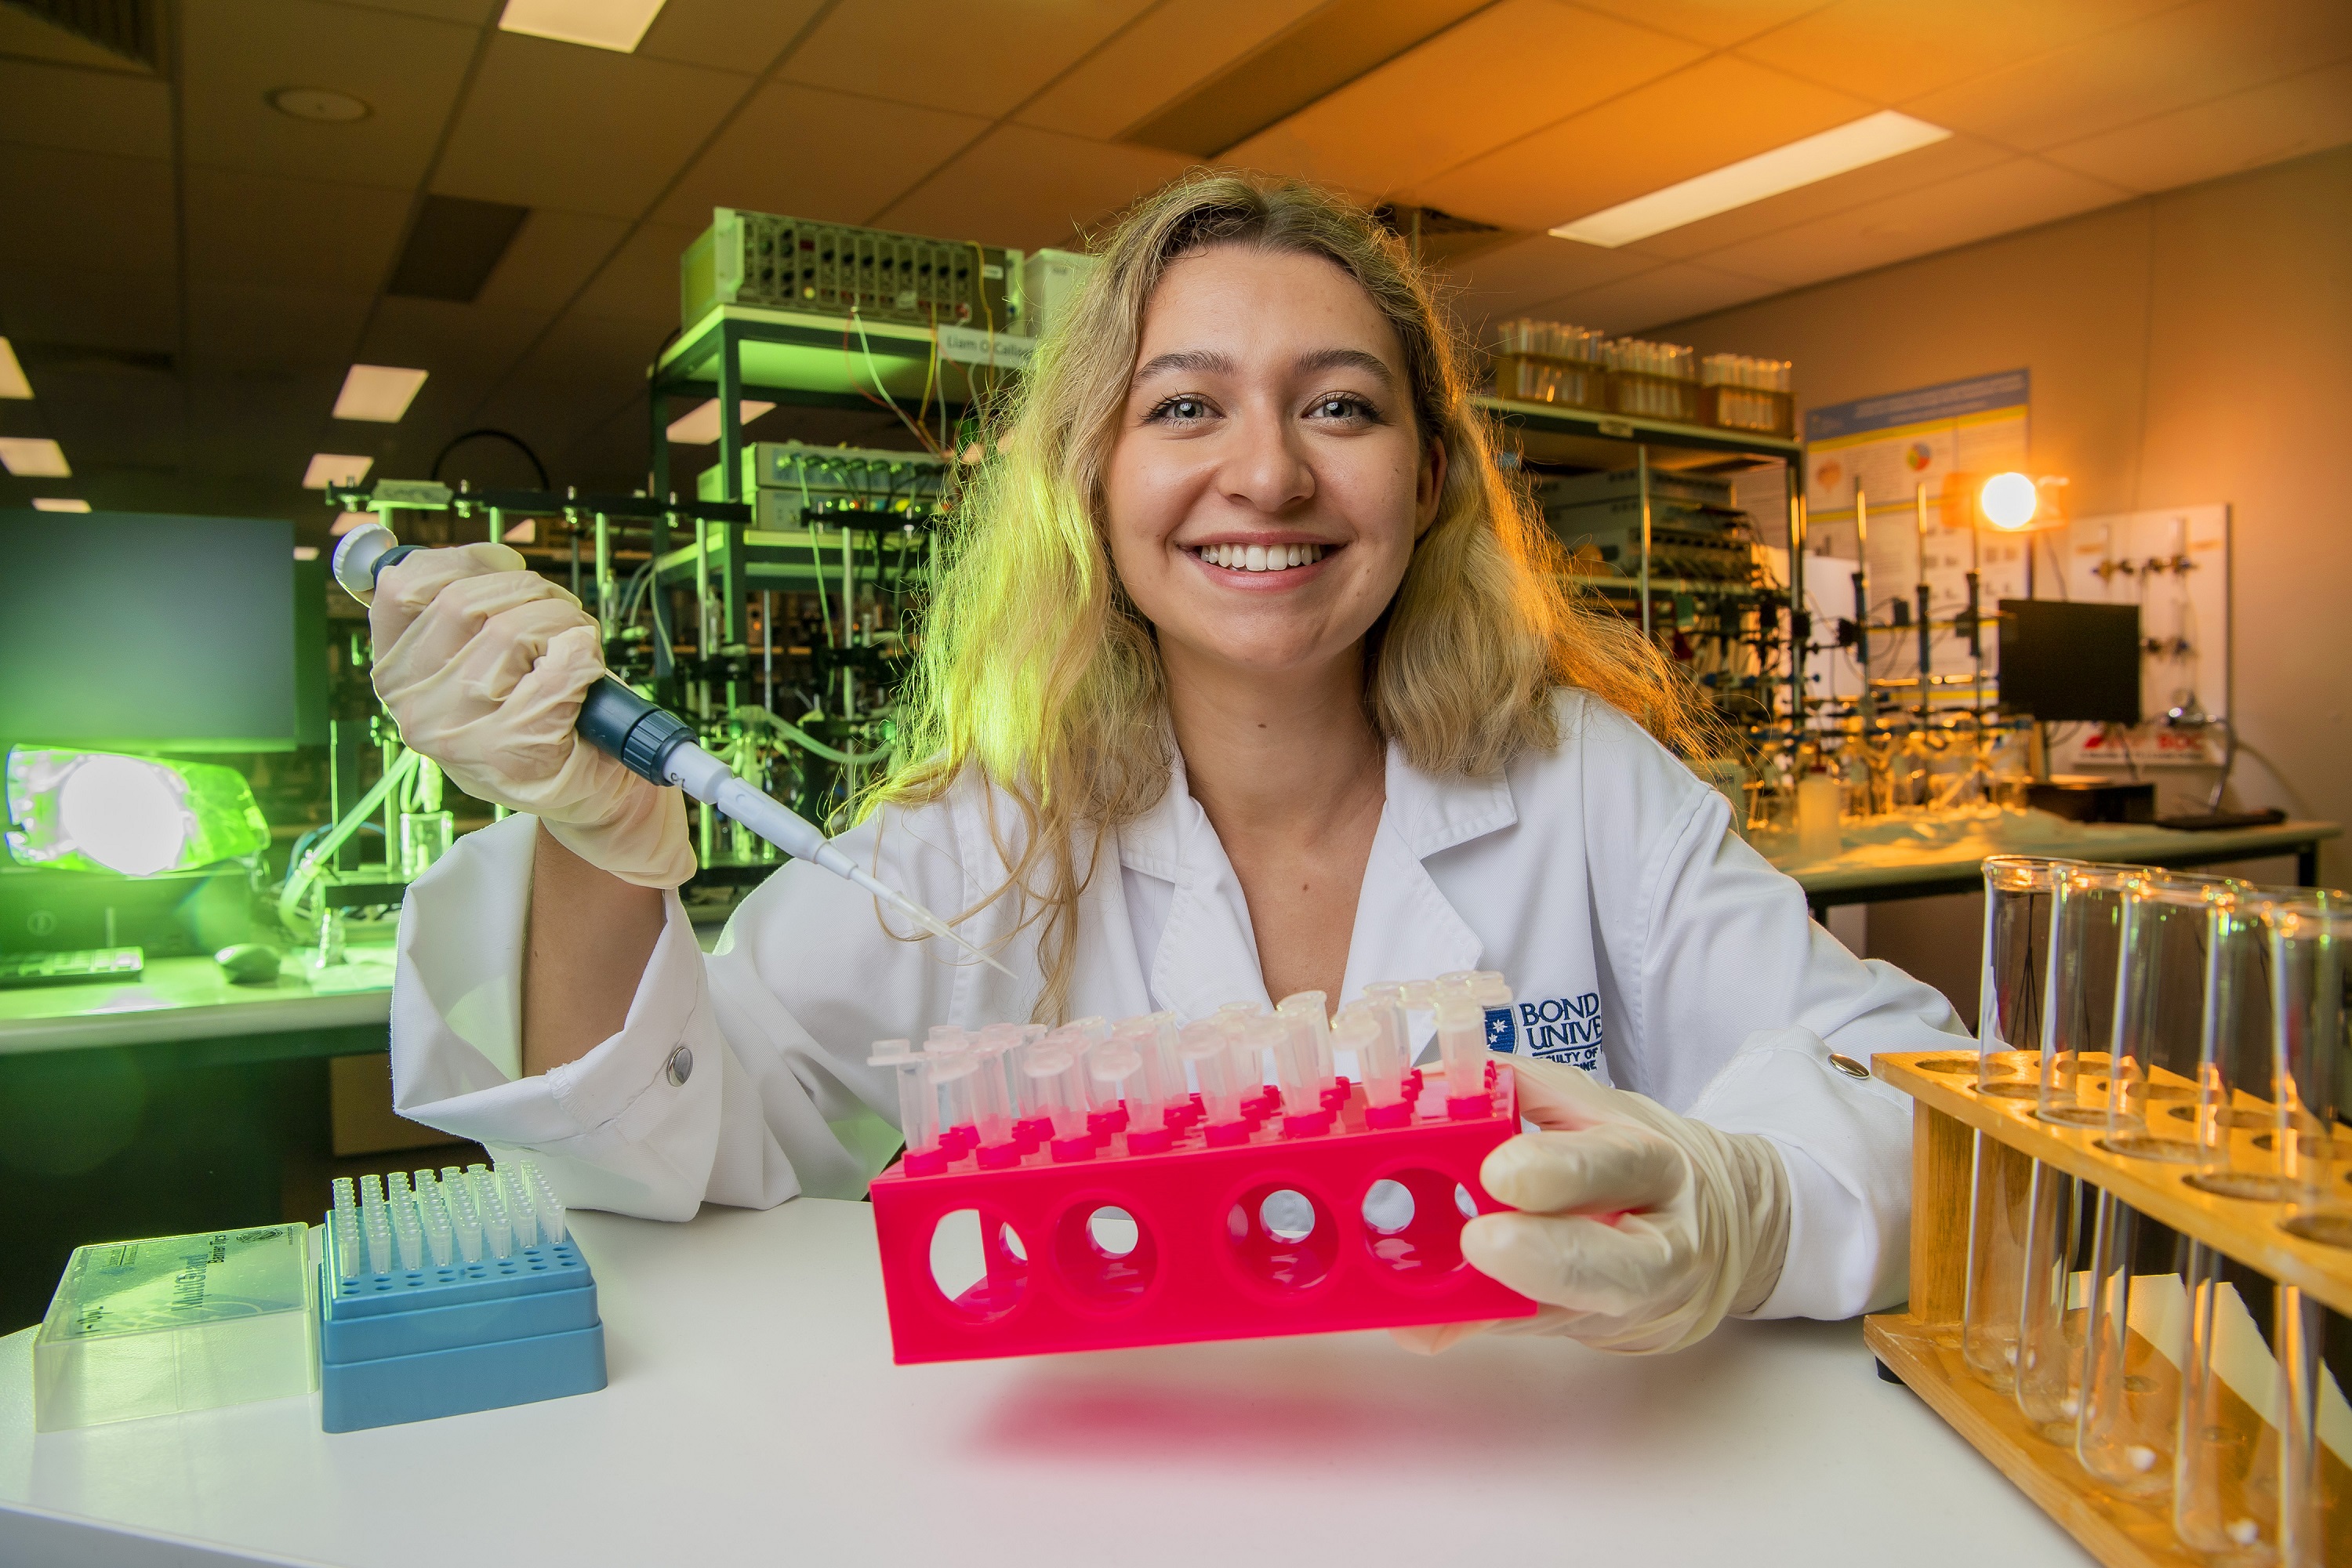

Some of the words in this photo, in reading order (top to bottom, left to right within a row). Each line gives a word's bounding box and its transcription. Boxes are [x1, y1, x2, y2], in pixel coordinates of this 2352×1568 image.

[1519, 992, 1599, 1026] BOND
[1526, 1014, 1602, 1050] UNIVE
[1584, 1047, 1598, 1059] OF
